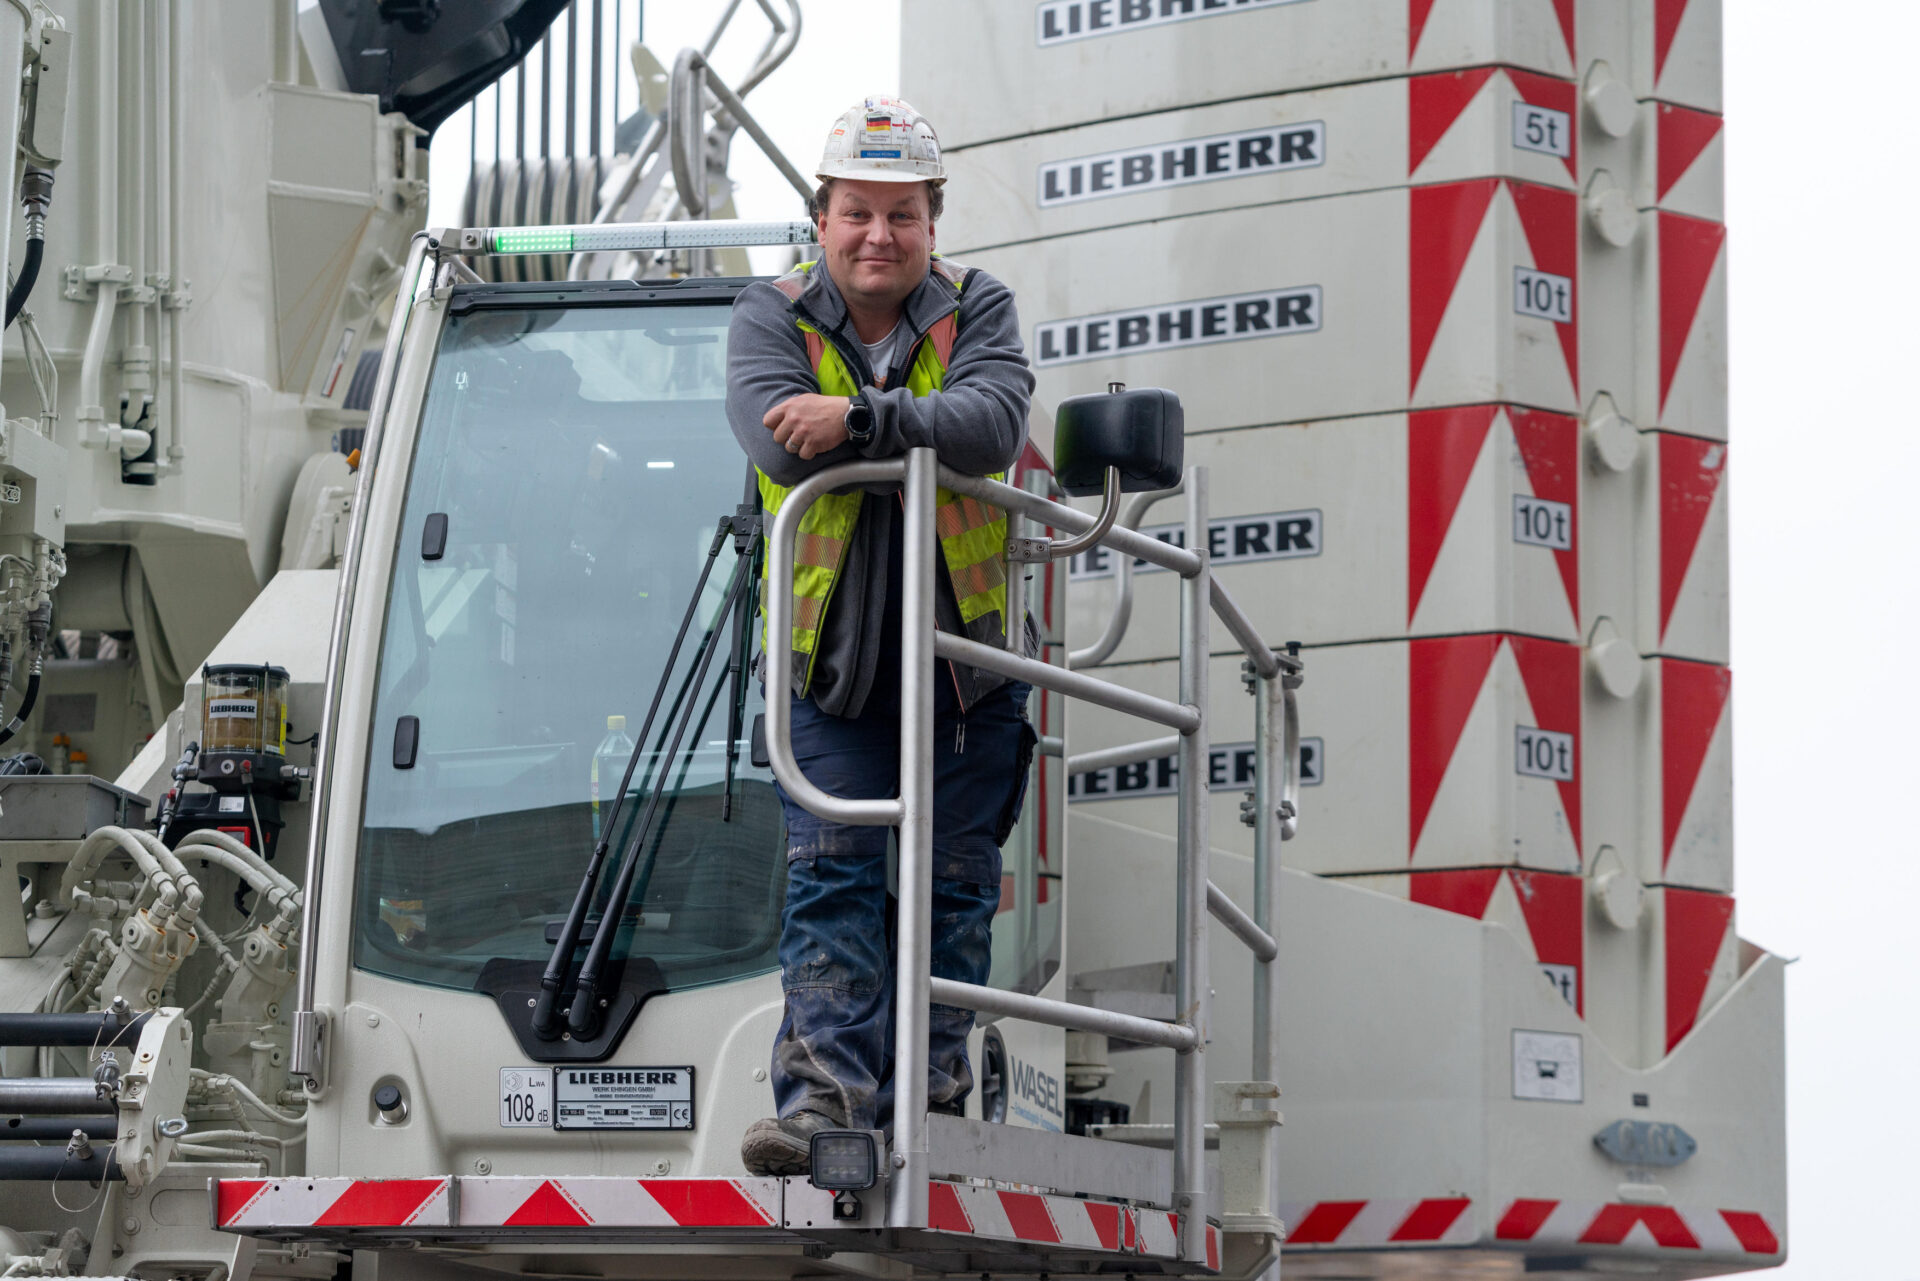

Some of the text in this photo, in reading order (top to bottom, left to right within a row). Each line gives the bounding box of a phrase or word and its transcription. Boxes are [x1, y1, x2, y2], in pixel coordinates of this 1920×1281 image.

[1526, 112, 1558, 149] 5t
[1044, 129, 1317, 201] LIEBHERR
[1040, 294, 1314, 361] LIEBHERR
[210, 704, 256, 713] LIEBHERR
[569, 1072, 677, 1085] LIEBHERR
[1011, 1054, 1063, 1118] WASEL
[504, 1093, 549, 1123] 108 dB
